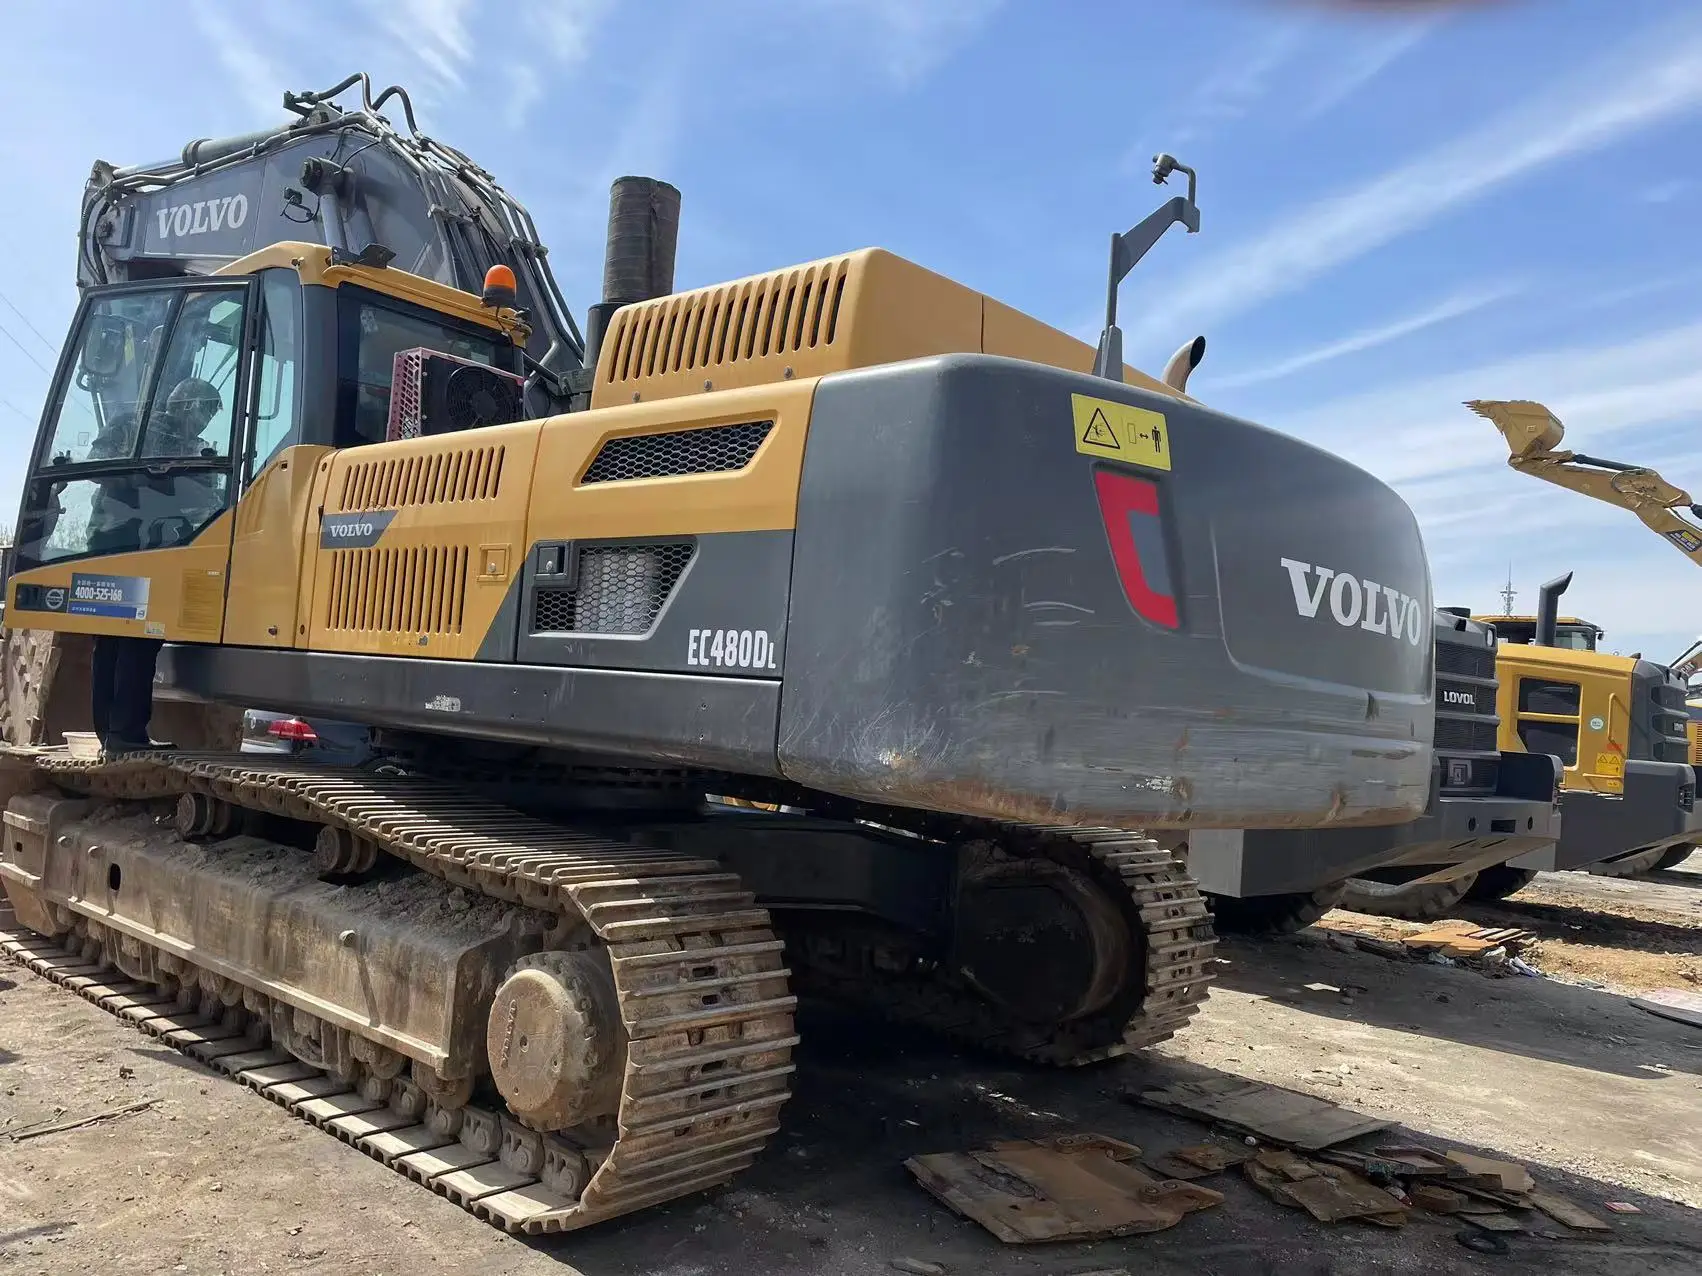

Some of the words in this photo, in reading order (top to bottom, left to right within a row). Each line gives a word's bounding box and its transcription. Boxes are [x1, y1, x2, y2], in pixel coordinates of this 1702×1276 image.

[157, 193, 248, 238] VOLVO
[331, 523, 373, 537] VOLVO
[1281, 557, 1421, 646] VOLVO
[1443, 690, 1475, 705] LOVOL
